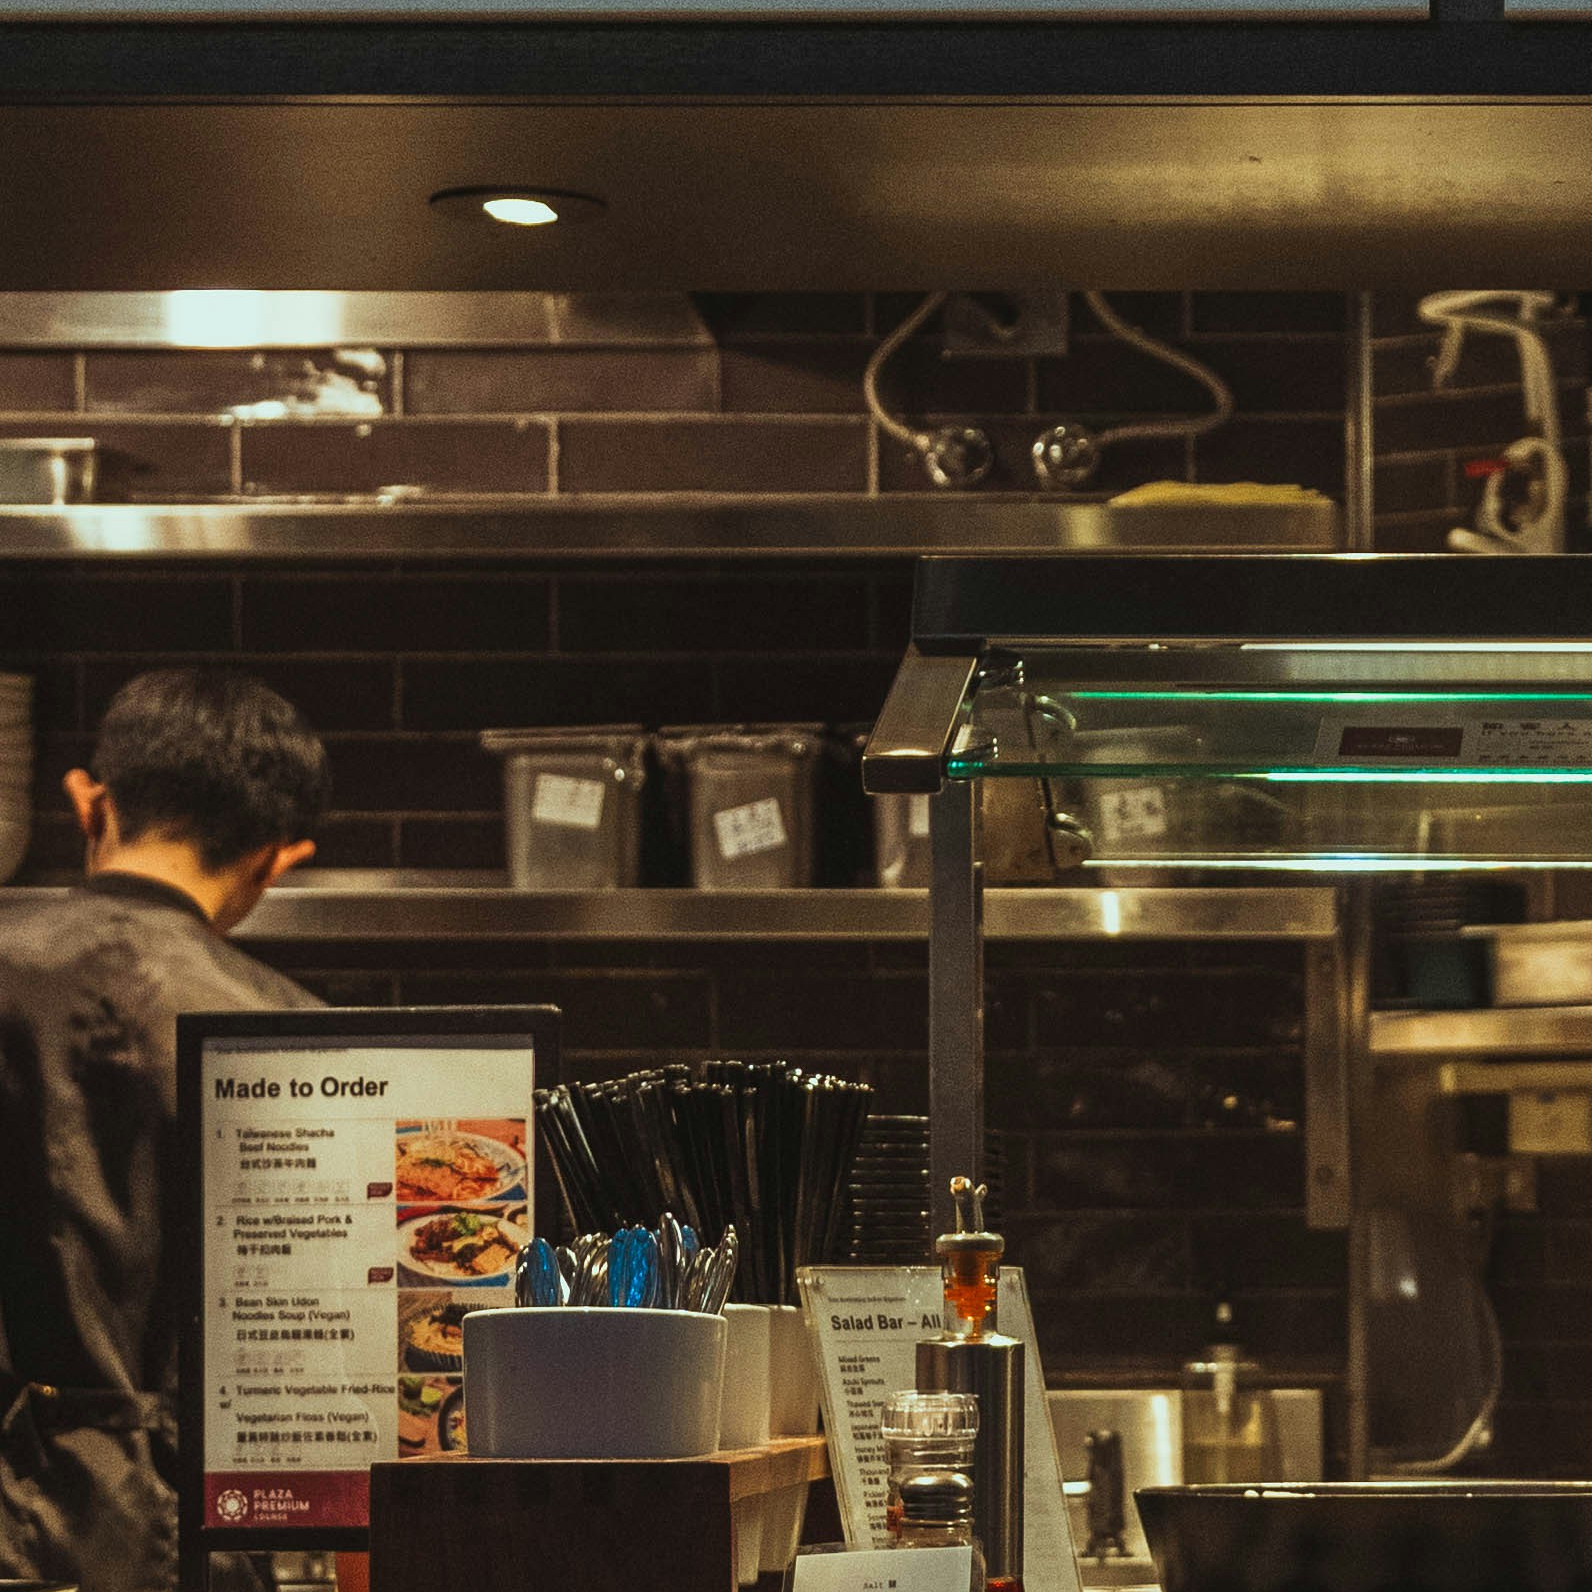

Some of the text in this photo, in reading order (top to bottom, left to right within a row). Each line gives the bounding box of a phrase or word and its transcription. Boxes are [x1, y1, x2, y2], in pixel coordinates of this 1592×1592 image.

[215, 1076, 389, 1098] Made to Order
[236, 1128, 292, 1138] Taiwanese
[240, 1142, 309, 1152] Beef Noodles
[236, 1215, 260, 1225] Rice
[317, 1215, 341, 1224] Pork
[345, 1215, 352, 1224] &
[234, 1229, 348, 1240] Preserved Vegetables
[236, 1297, 262, 1307] Bean
[266, 1296, 288, 1306] Skin
[291, 1296, 319, 1306] Udon
[233, 1310, 351, 1321] Noodles Soup (Vegan)
[831, 1315, 874, 1330] Salad
[877, 1314, 903, 1329] Bar
[921, 1313, 941, 1329] All
[285, 1385, 337, 1396] Vegetable
[237, 1412, 292, 1424] Vegetarian
[327, 1411, 369, 1423] (Vegan)
[254, 1489, 293, 1498] PLAZA
[254, 1500, 310, 1510] PREMIUM
